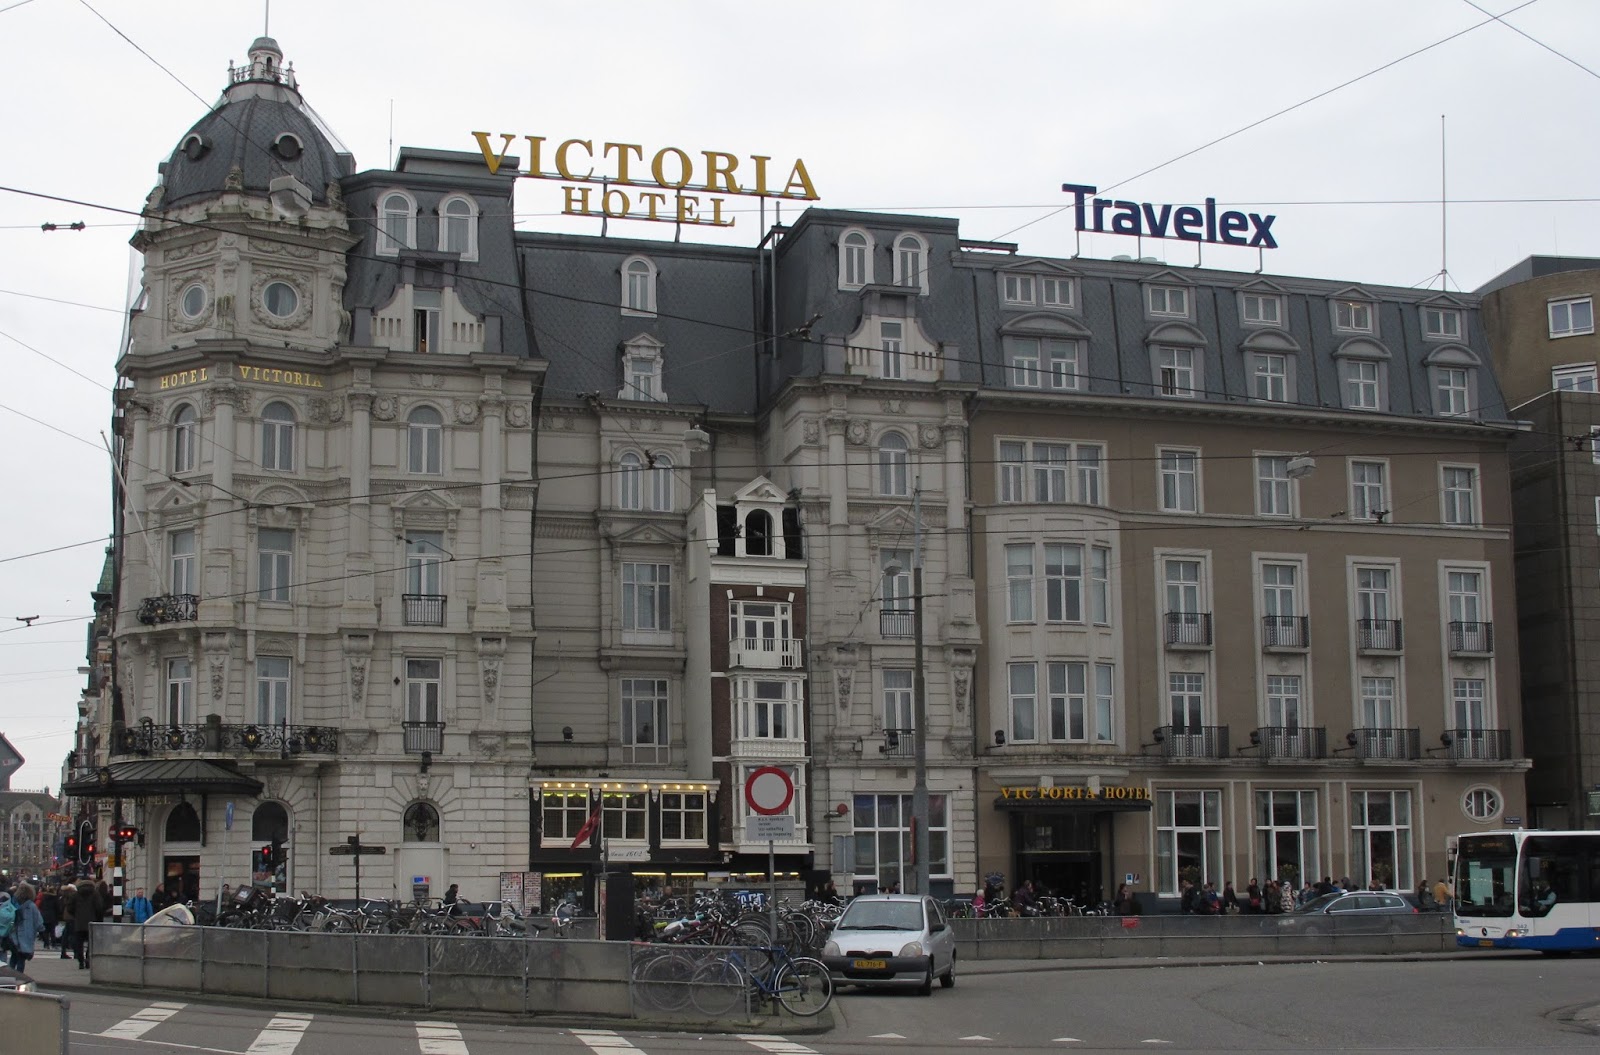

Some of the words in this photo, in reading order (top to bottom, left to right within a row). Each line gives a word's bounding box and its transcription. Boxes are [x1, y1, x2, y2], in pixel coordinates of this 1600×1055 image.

[471, 131, 820, 201] VICTORIA
[561, 186, 735, 227] HOTEL
[1062, 183, 1278, 249] Travelex
[160, 368, 208, 389] HOTEL
[239, 365, 323, 388] VICTORIA
[1001, 786, 1096, 799] VICTORIA
[1105, 786, 1151, 799] HOTEL
